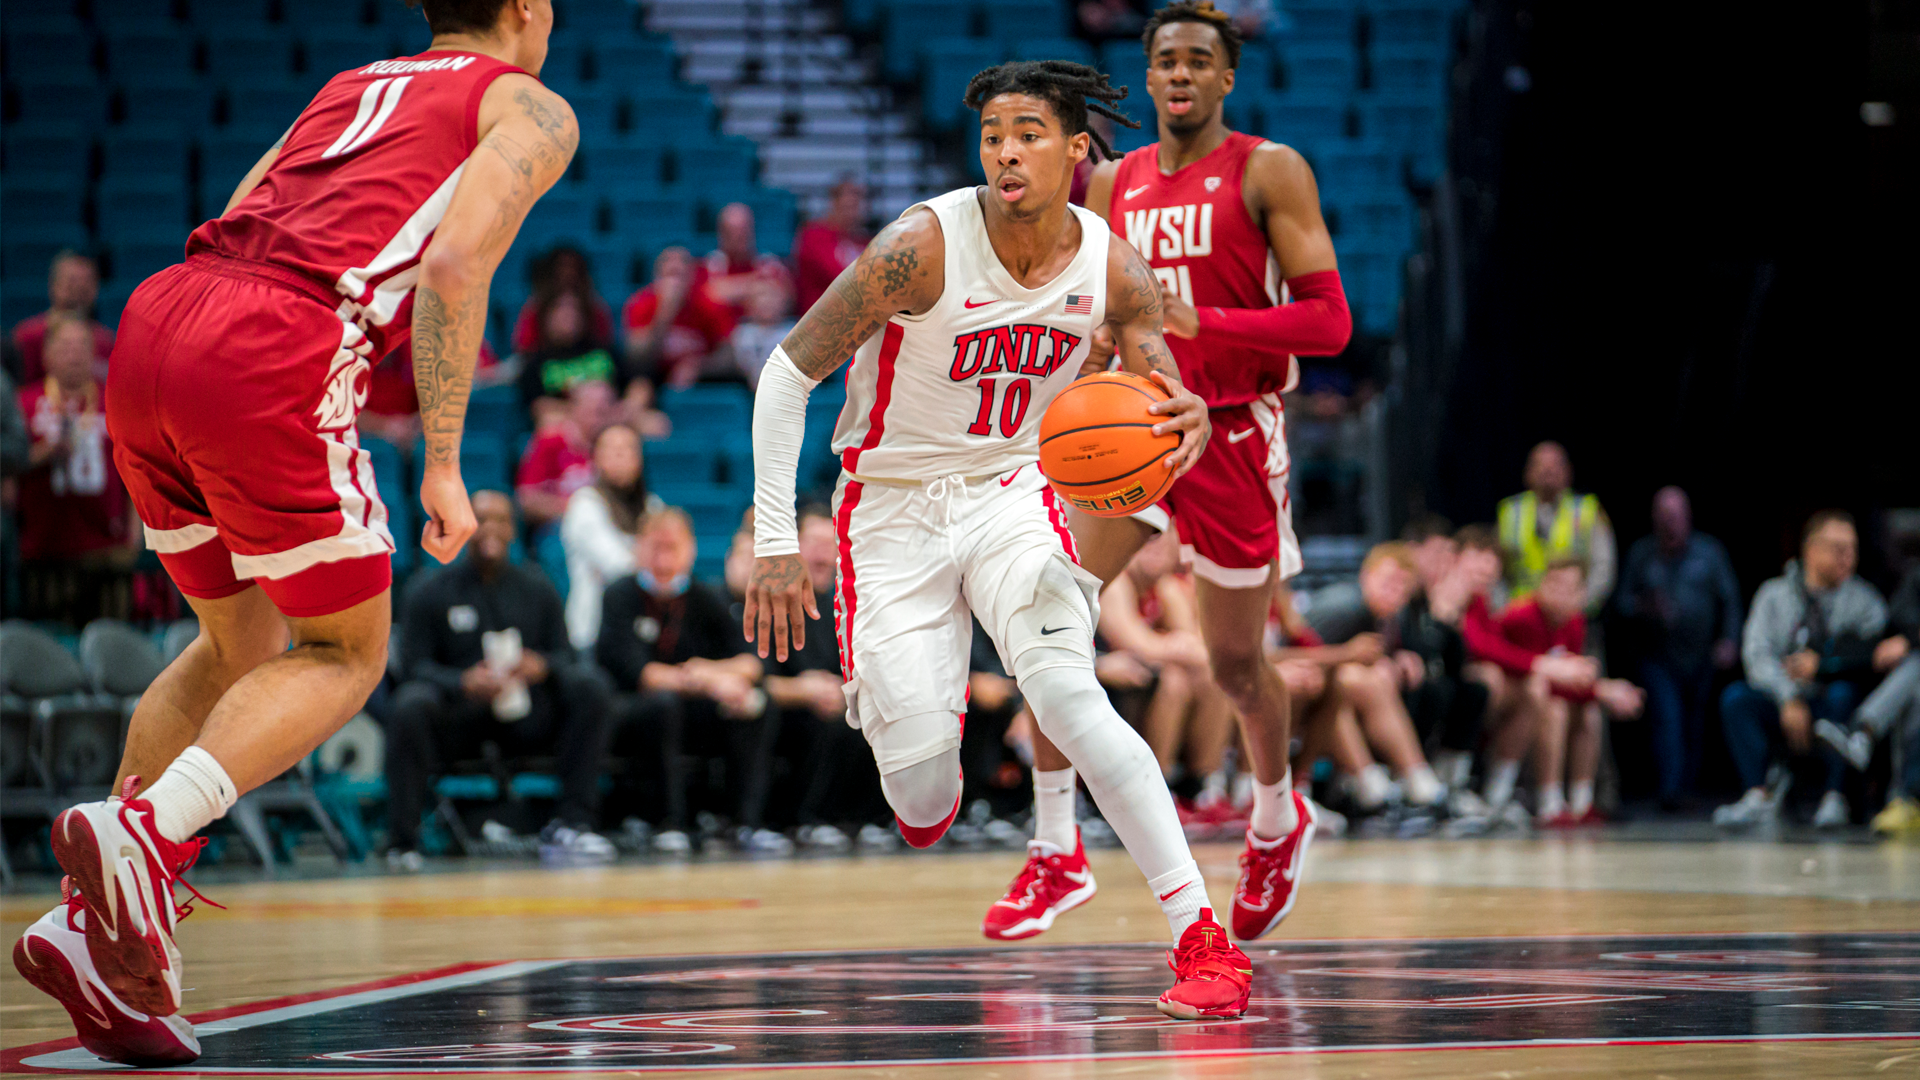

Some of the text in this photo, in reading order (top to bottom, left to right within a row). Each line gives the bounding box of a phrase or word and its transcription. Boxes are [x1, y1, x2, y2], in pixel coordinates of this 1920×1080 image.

[321, 75, 414, 159] 11
[1124, 203, 1213, 261] WSU
[949, 323, 1082, 382] UNLV
[967, 377, 1031, 439] 10
[1071, 484, 1148, 511] ELITE
